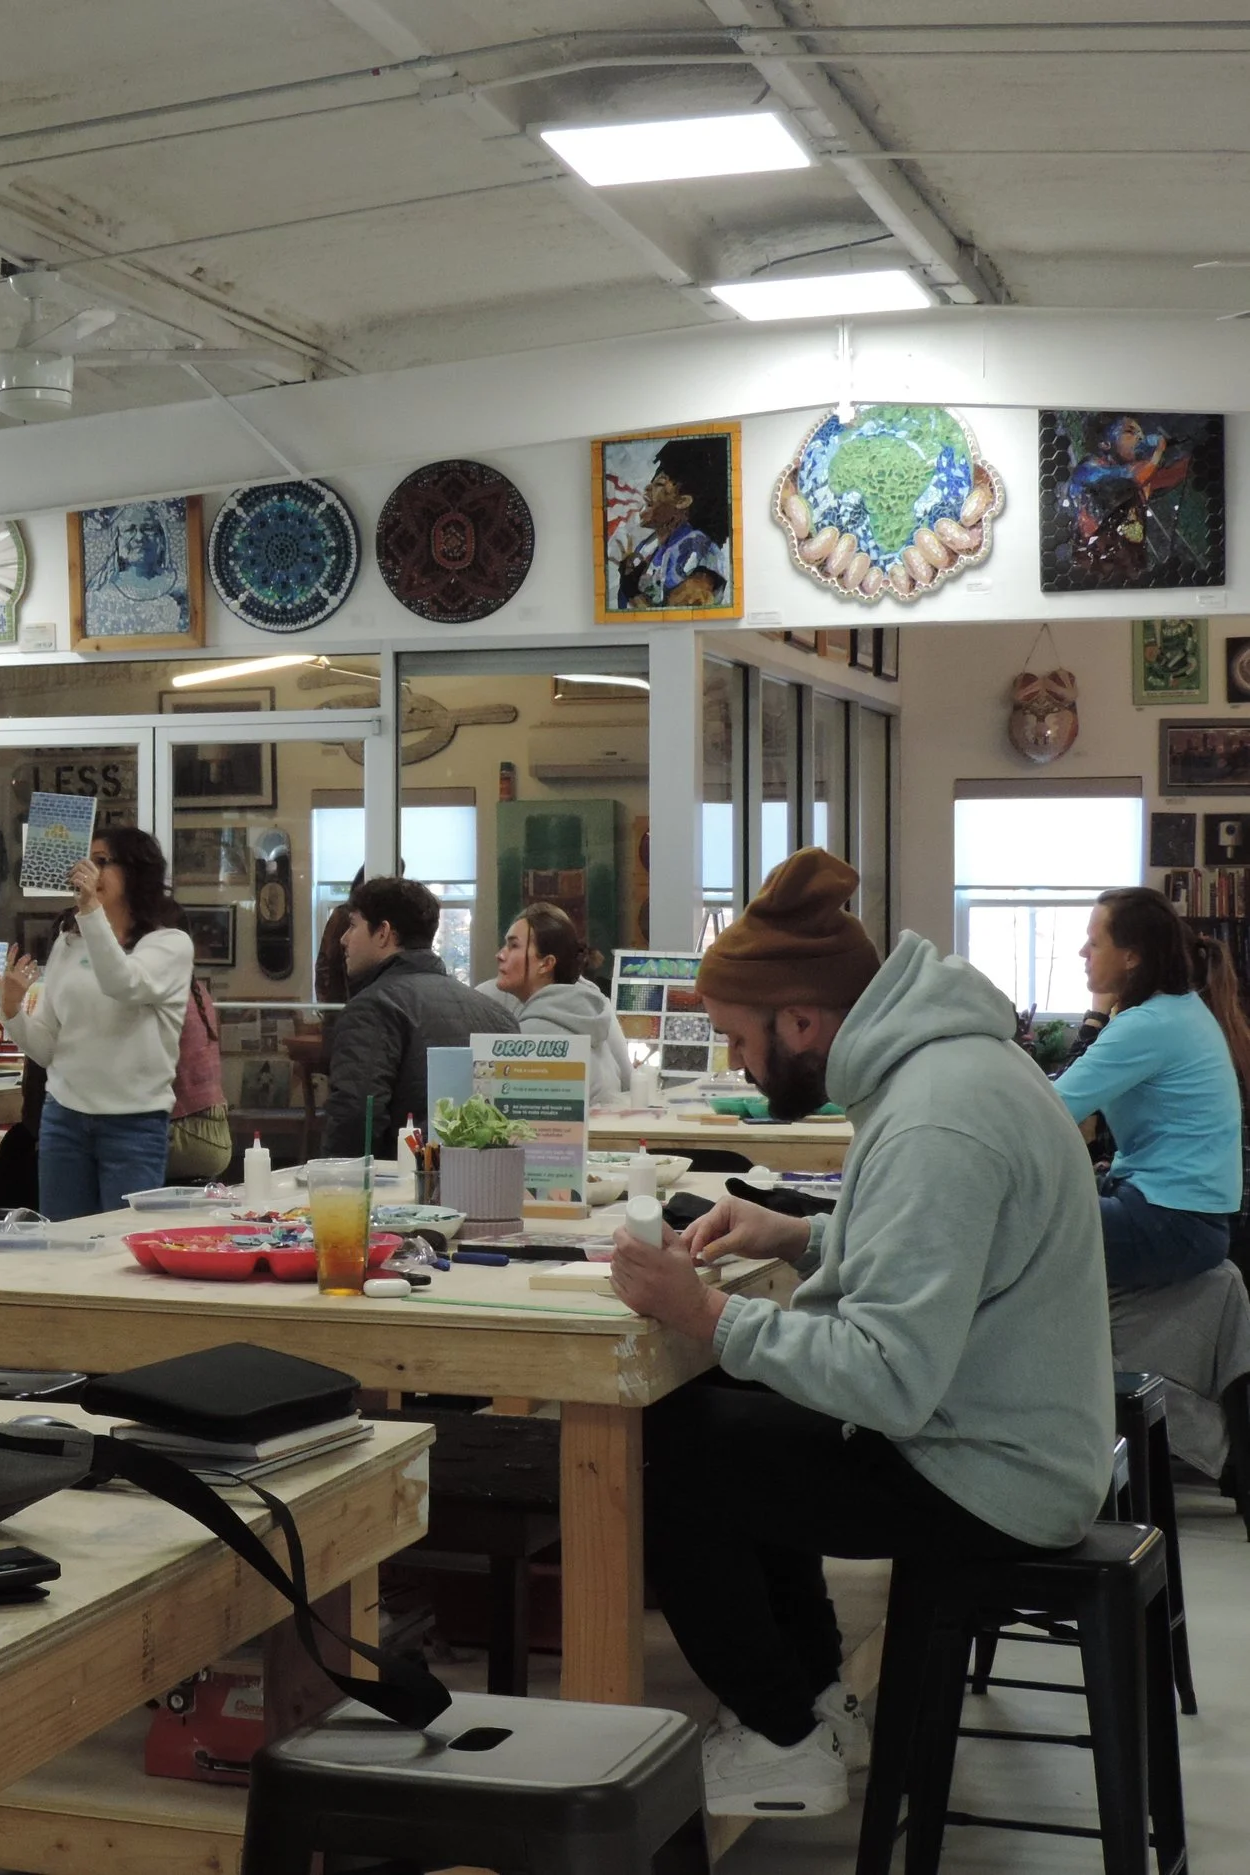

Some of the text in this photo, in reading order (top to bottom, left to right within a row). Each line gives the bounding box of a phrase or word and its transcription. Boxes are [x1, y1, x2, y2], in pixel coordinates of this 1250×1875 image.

[492, 1040, 570, 1058] DROP INS!
[502, 1103, 510, 1115] 3
